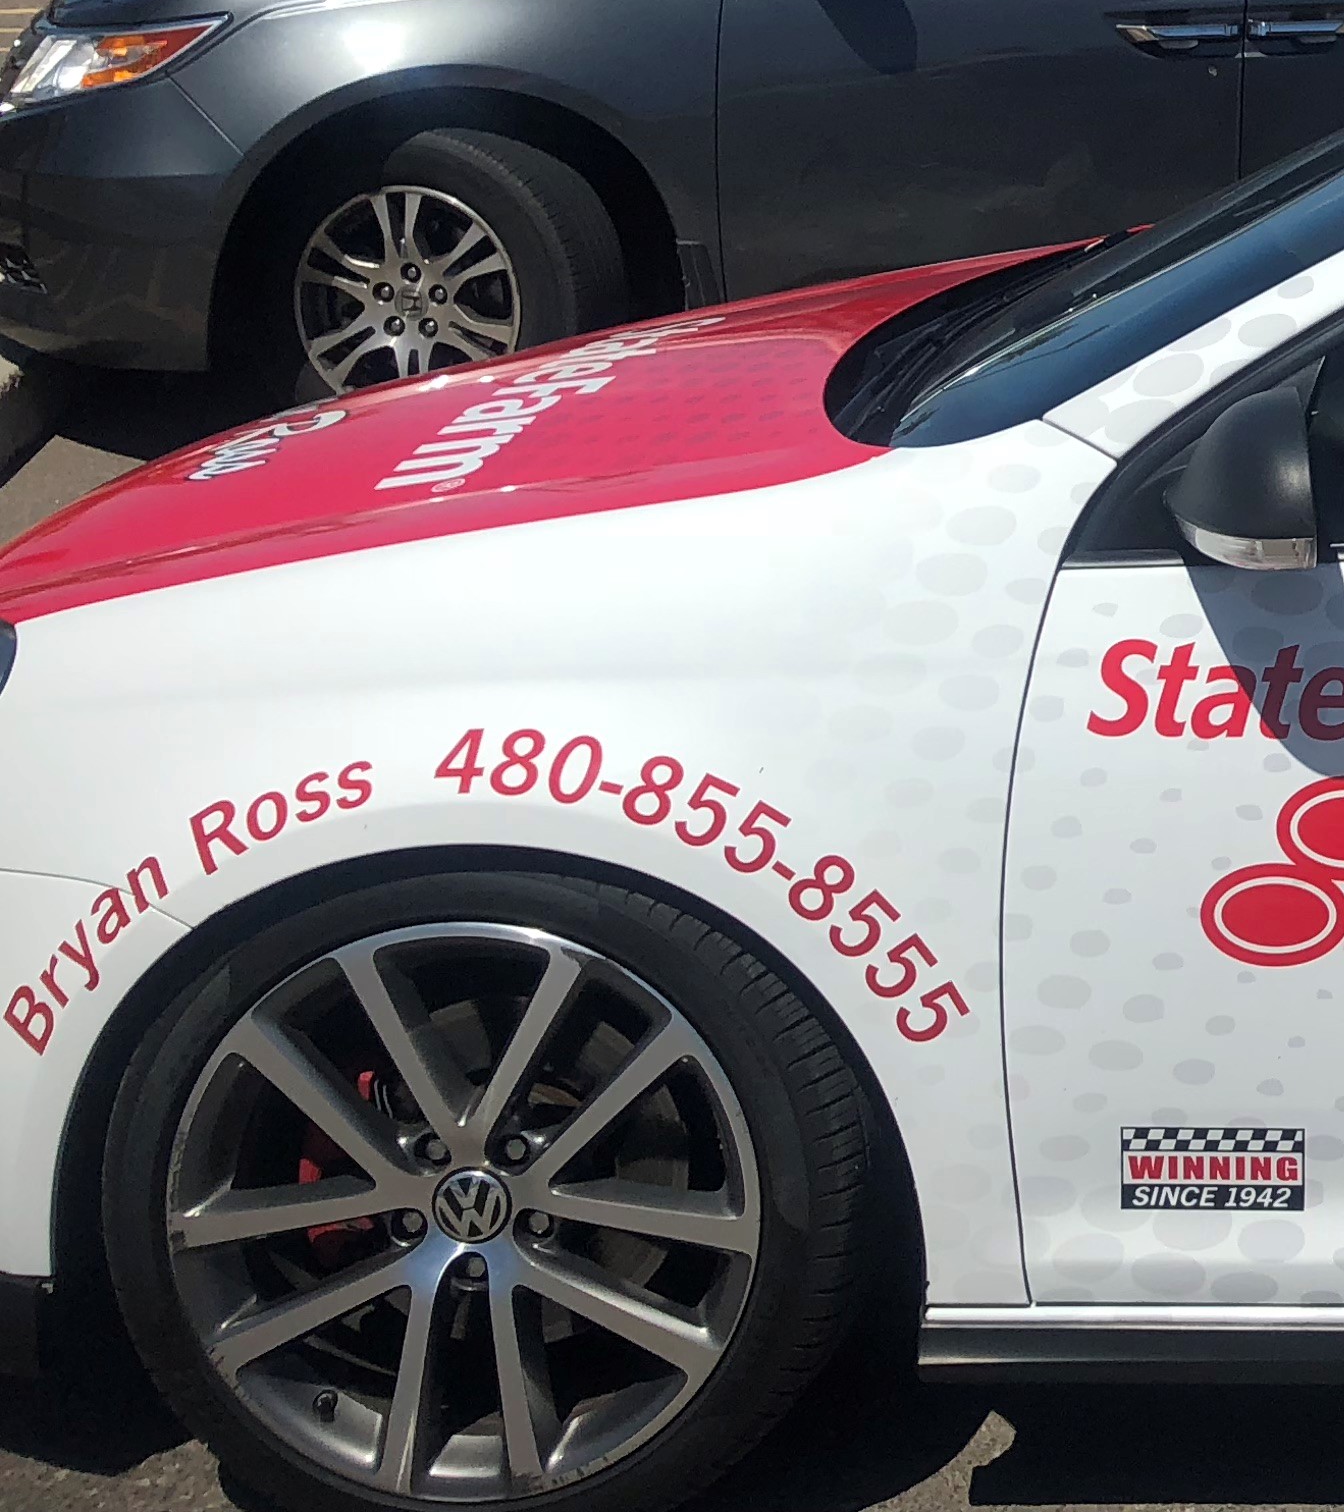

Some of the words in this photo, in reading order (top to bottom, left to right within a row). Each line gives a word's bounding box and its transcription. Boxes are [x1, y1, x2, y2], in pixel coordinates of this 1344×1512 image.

[4, 856, 170, 1055] Bryan
[190, 760, 374, 874] Ross
[434, 727, 970, 1044] 480-855-8555
[1128, 1155, 1299, 1182] WINNING
[1131, 1186, 1218, 1207] SINCE
[1225, 1186, 1292, 1207] 1942
